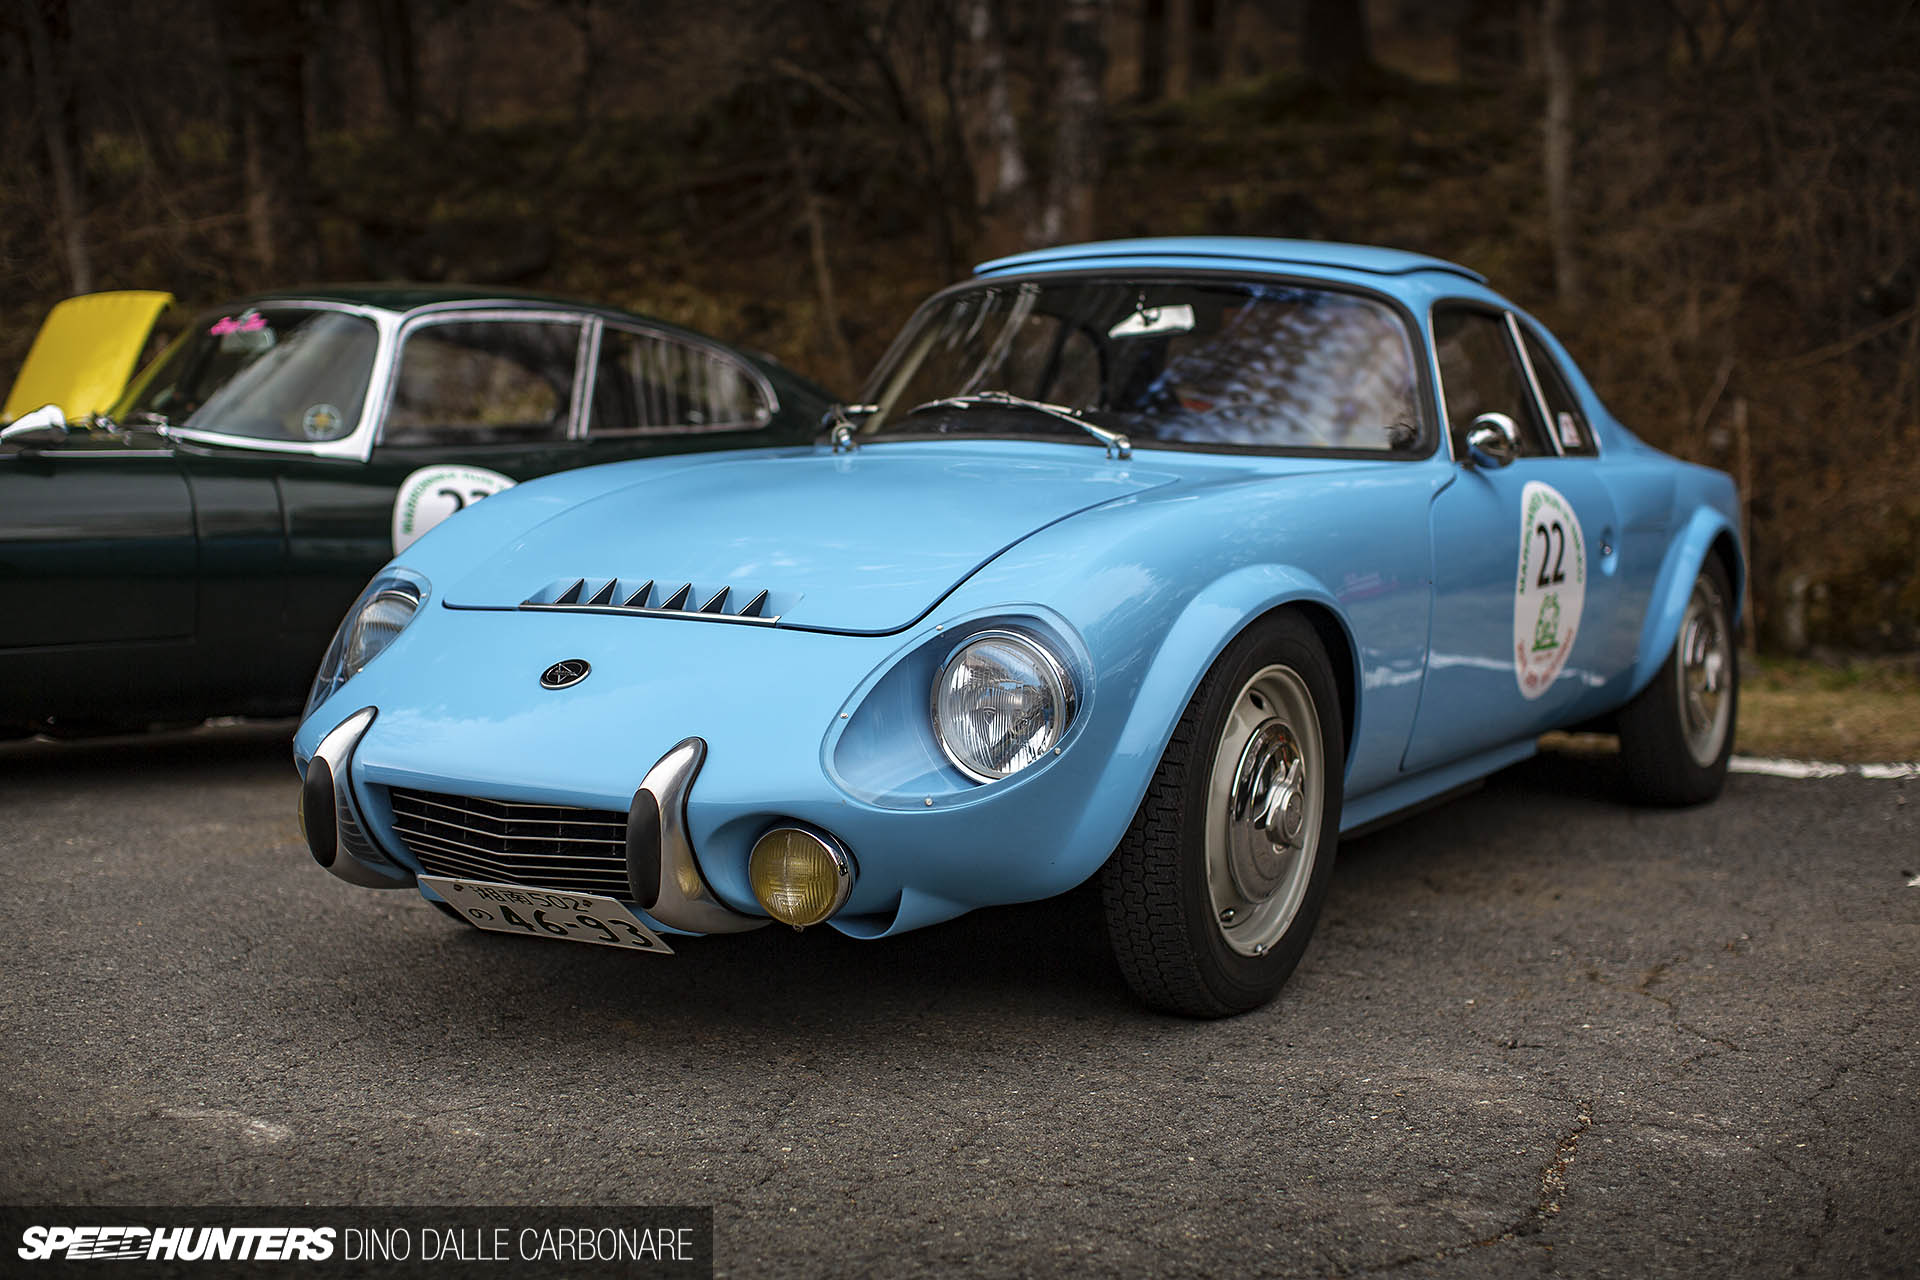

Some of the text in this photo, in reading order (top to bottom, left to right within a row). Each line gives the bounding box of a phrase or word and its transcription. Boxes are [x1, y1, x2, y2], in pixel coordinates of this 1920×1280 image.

[1537, 522, 1564, 588] 22
[468, 885, 589, 912] 湘南502
[468, 904, 653, 947] の 46-93
